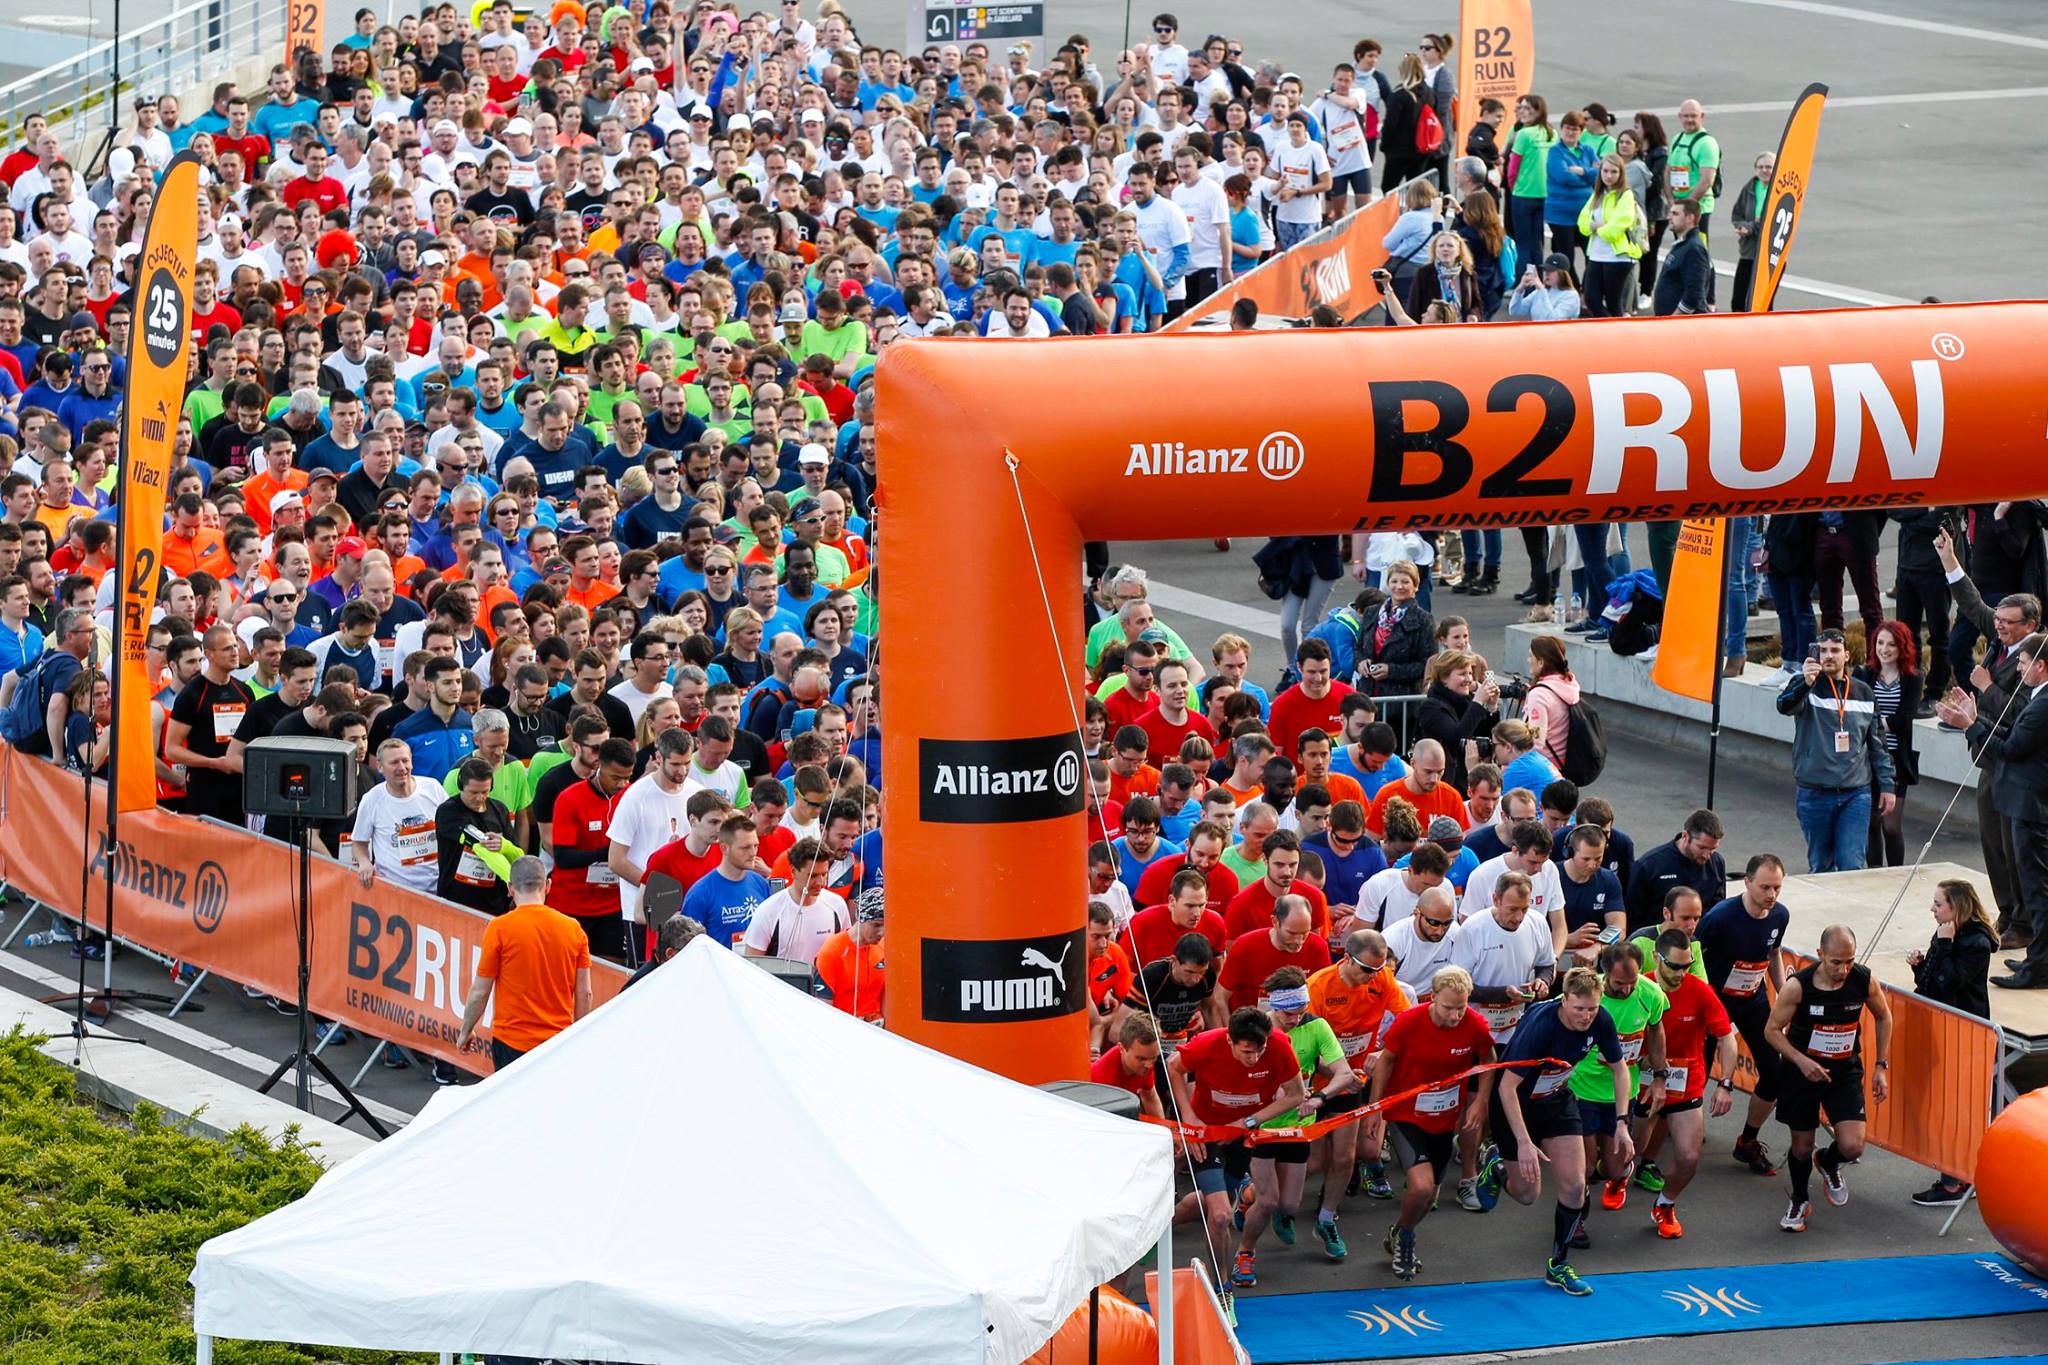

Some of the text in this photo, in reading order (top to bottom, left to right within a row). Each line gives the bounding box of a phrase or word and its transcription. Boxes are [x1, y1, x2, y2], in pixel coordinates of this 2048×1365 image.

[1475, 26, 1513, 58] B2
[1475, 61, 1516, 80] RUN
[148, 284, 178, 332] 25
[146, 332, 177, 352] minutes
[1367, 358, 1945, 505] B2RUN
[1124, 441, 1249, 476] Allianz
[1353, 491, 1926, 531] LE RUNNING DES ENTREPRISES
[933, 764, 1048, 795] Allianz
[89, 829, 187, 910] Allianz
[721, 905, 746, 916] Arras
[347, 901, 495, 1029] B2RU
[960, 976, 1054, 1011] PUMA
[346, 985, 358, 1009] LE
[360, 991, 416, 1030] RUNNING
[417, 1013, 439, 1040] DES
